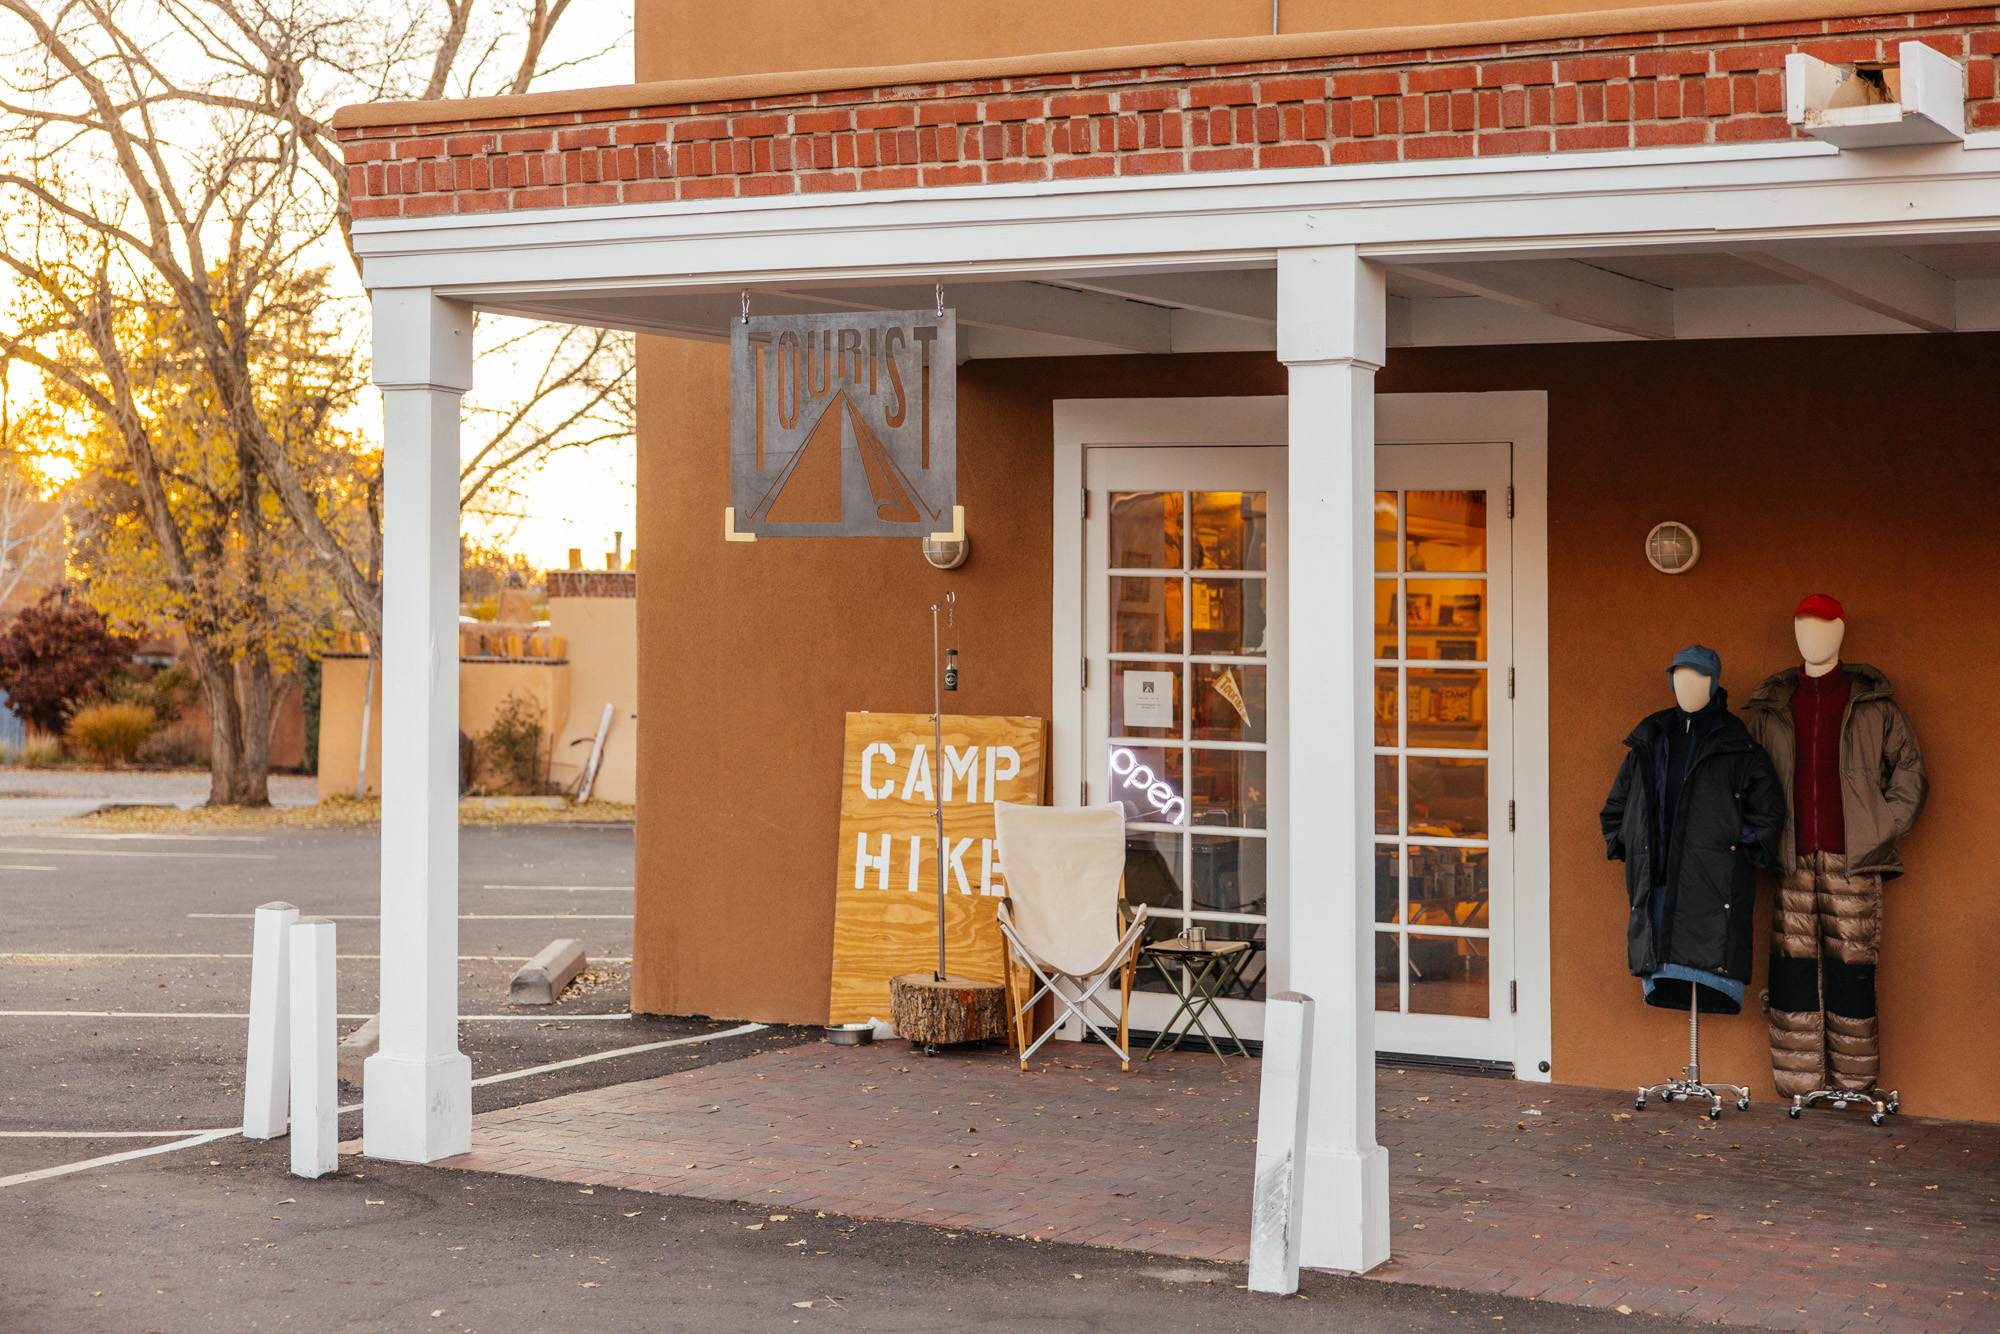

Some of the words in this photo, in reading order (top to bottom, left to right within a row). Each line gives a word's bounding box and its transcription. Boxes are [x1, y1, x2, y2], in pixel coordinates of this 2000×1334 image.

[748, 326, 938, 472] TOURIST
[861, 743, 1021, 803] CAMP
[1110, 748, 1185, 826] open
[854, 832, 1005, 897] HIKE
